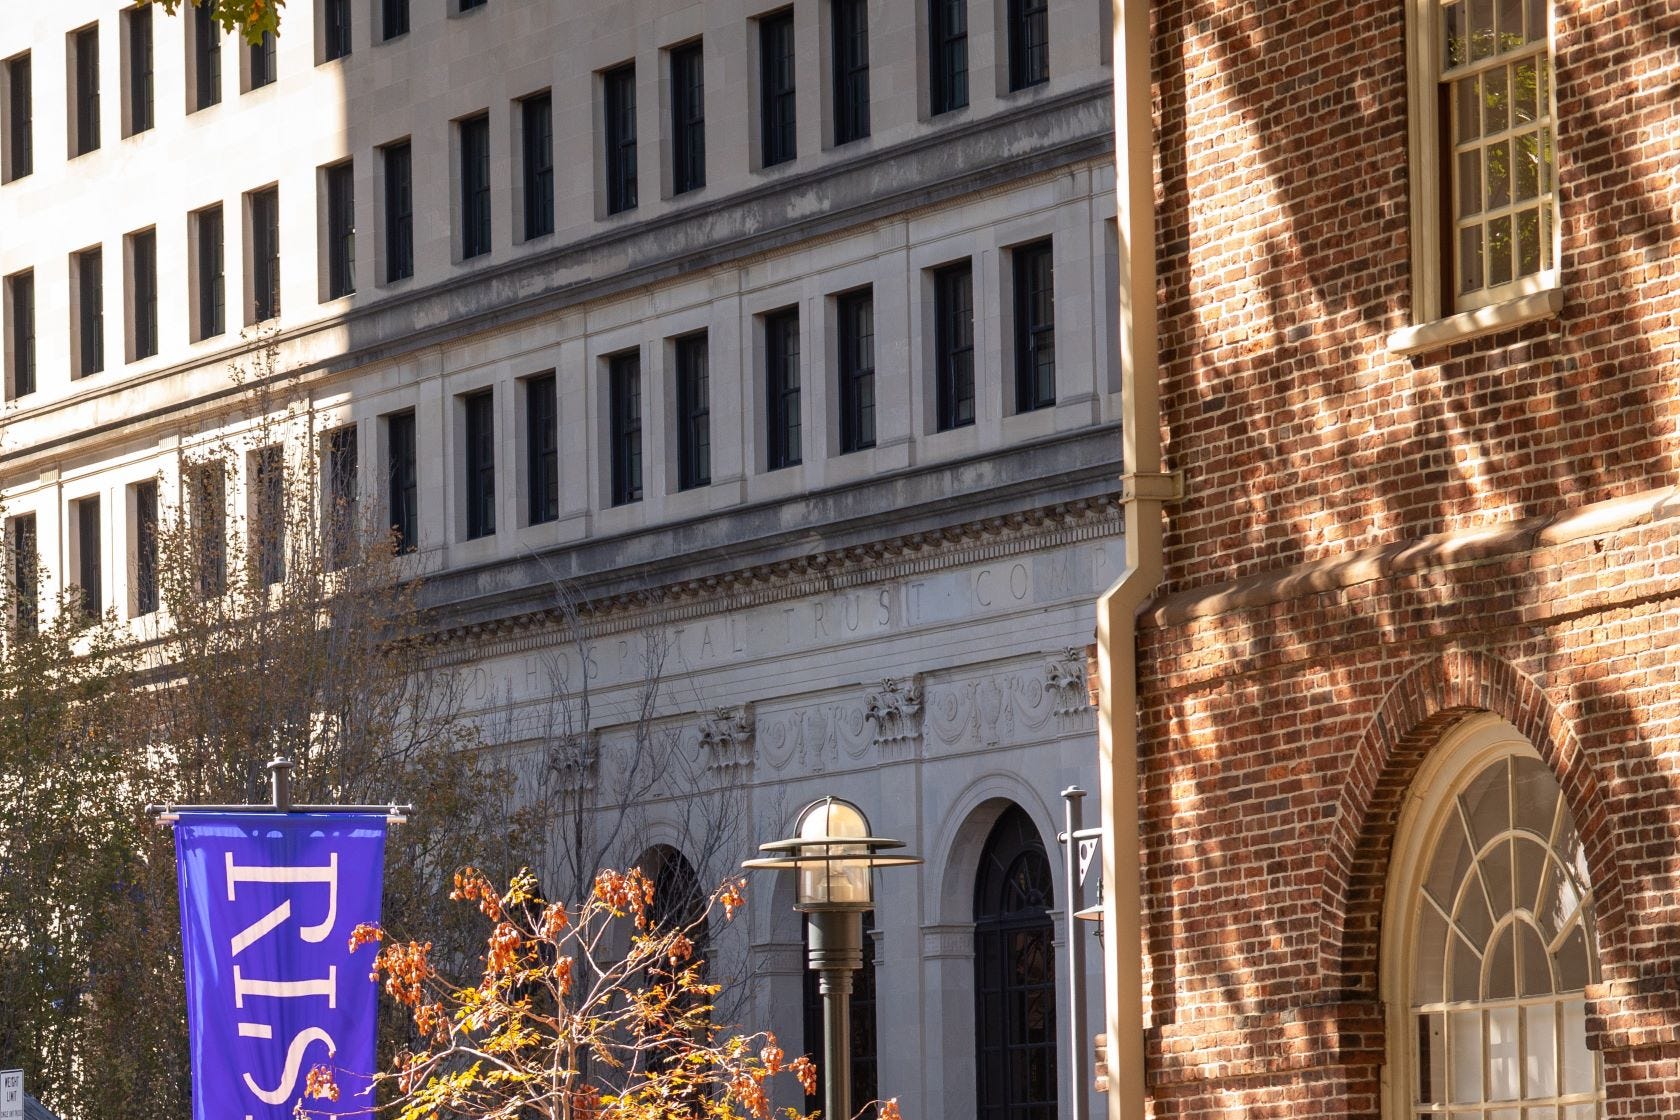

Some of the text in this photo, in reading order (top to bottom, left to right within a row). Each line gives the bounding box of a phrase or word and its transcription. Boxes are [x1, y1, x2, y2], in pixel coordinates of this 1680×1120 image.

[525, 614, 744, 691] HOSPTAL
[783, 582, 926, 644] TRUST
[4, 1075, 19, 1088] WEIGHT
[6, 1091, 17, 1102] LIMIT
